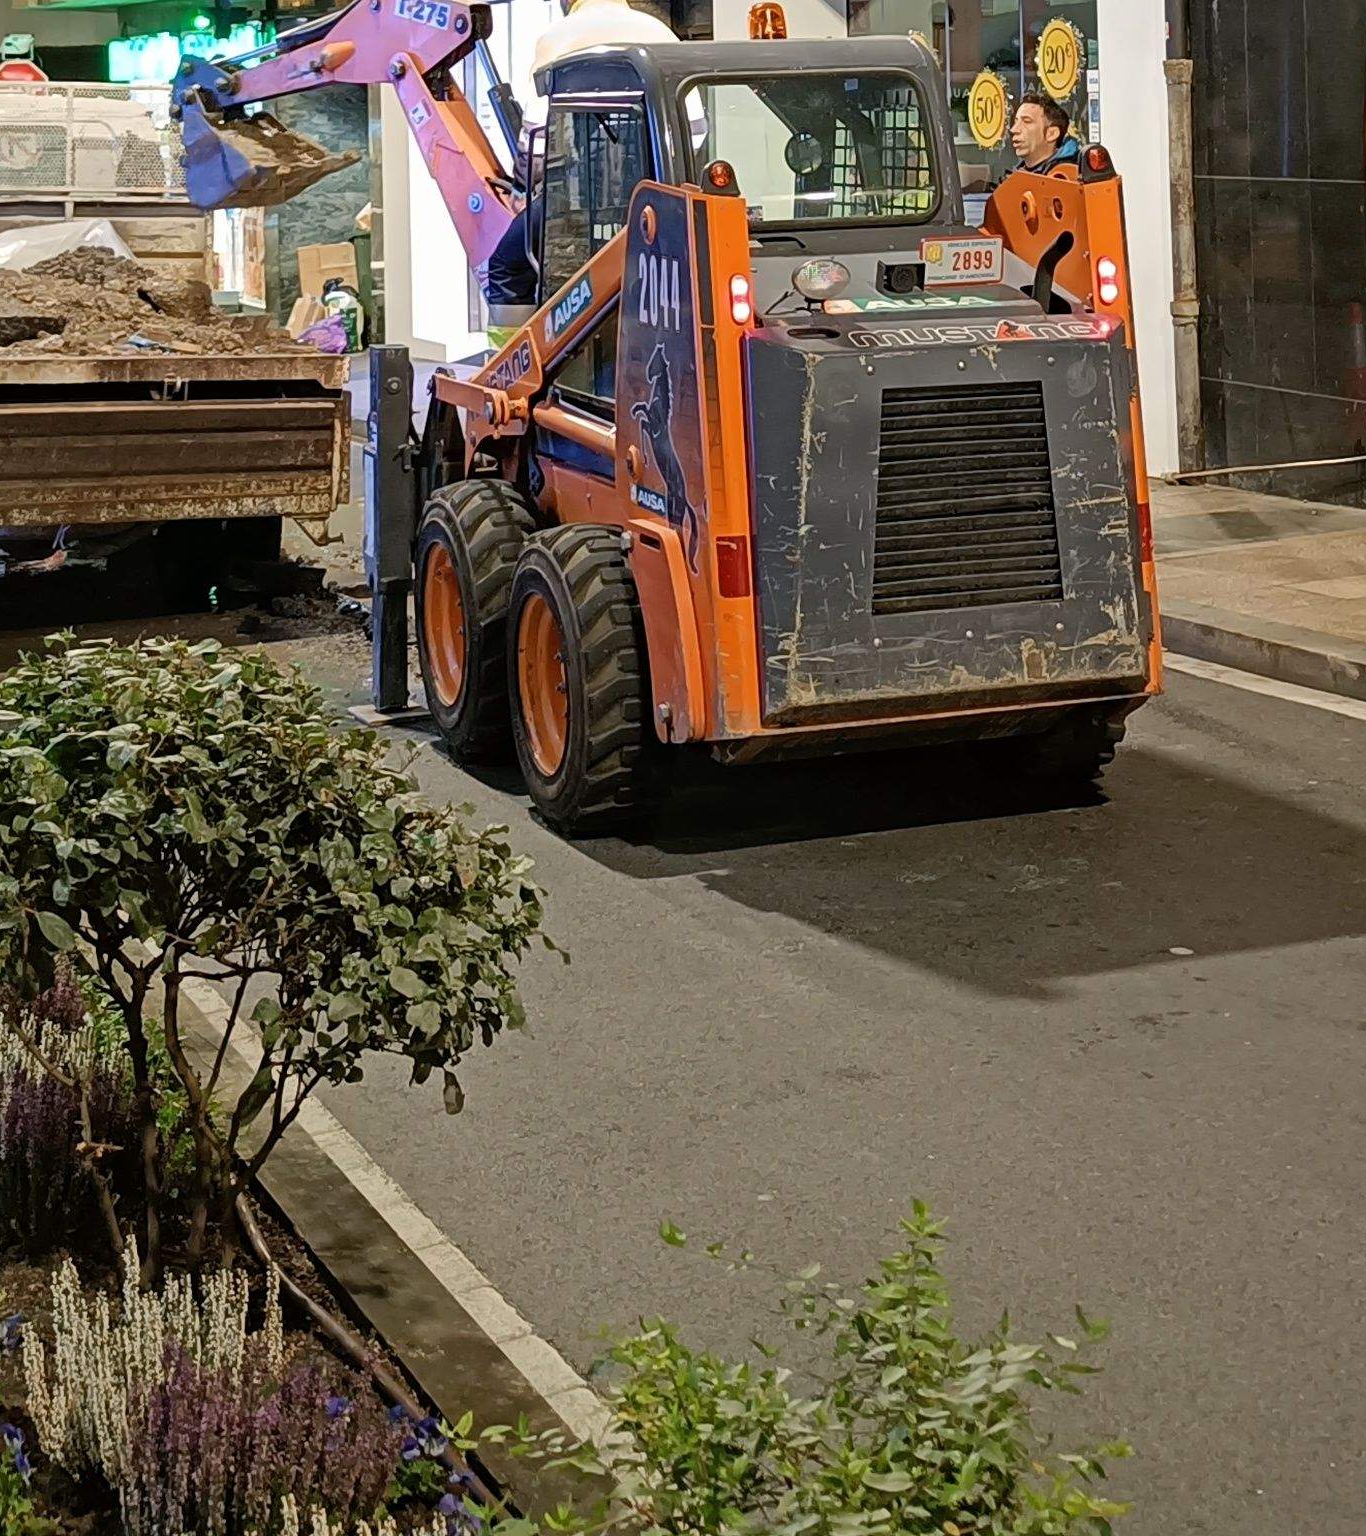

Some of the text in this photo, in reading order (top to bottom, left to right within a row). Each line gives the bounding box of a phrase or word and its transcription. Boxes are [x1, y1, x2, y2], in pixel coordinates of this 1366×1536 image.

[1045, 41, 1074, 75] 20€
[975, 93, 1002, 125] 50€
[951, 250, 993, 272] 2899
[553, 279, 592, 332] AUSA
[638, 252, 681, 332] 2044
[863, 295, 993, 310] AUSA
[848, 320, 1103, 347] MUSTANG
[637, 489, 666, 513] AUSA
